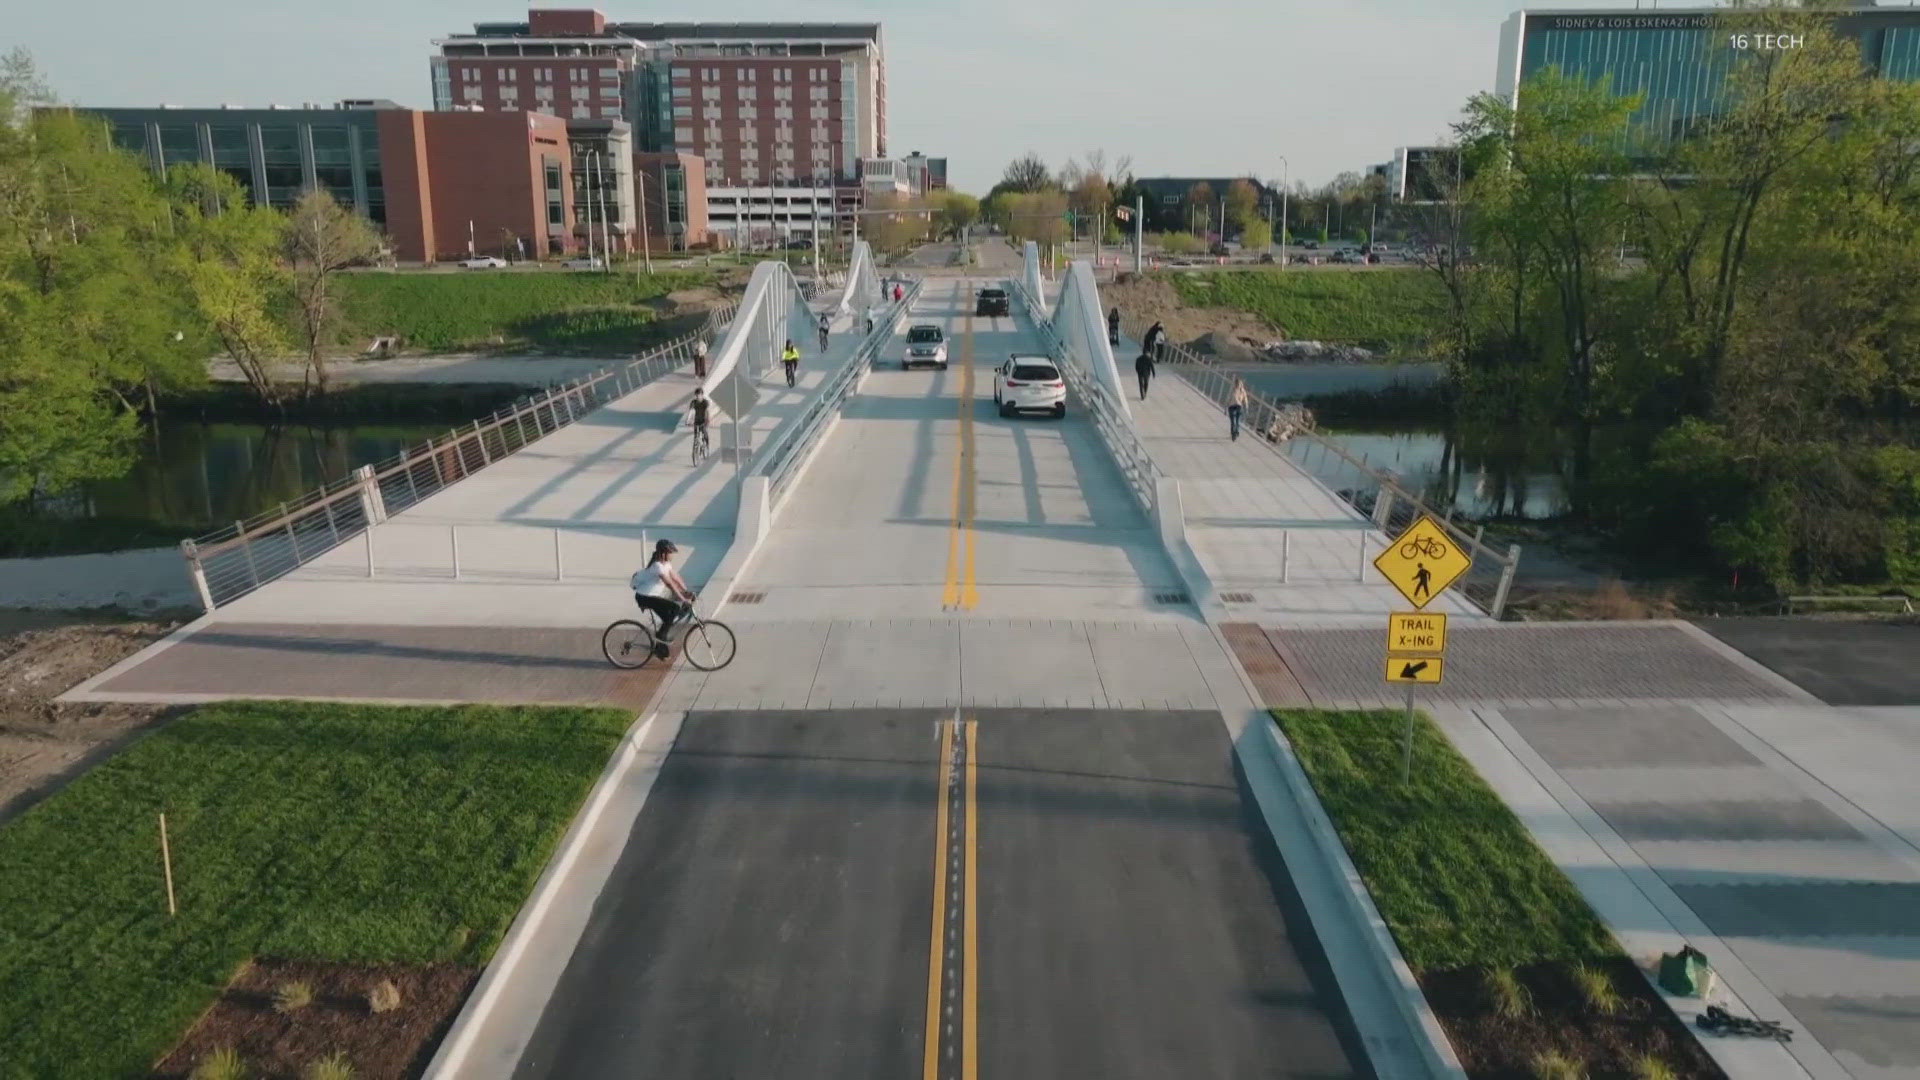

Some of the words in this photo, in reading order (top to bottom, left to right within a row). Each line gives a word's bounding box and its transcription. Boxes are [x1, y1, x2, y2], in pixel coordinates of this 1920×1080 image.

[1555, 18, 1595, 28] SIDNEY
[1597, 18, 1605, 28] &
[1608, 18, 1632, 28] LOIS
[1634, 17, 1688, 28] ESKENAZI
[1400, 619, 1435, 630] TRAIL
[1399, 635, 1434, 647] X-ING
